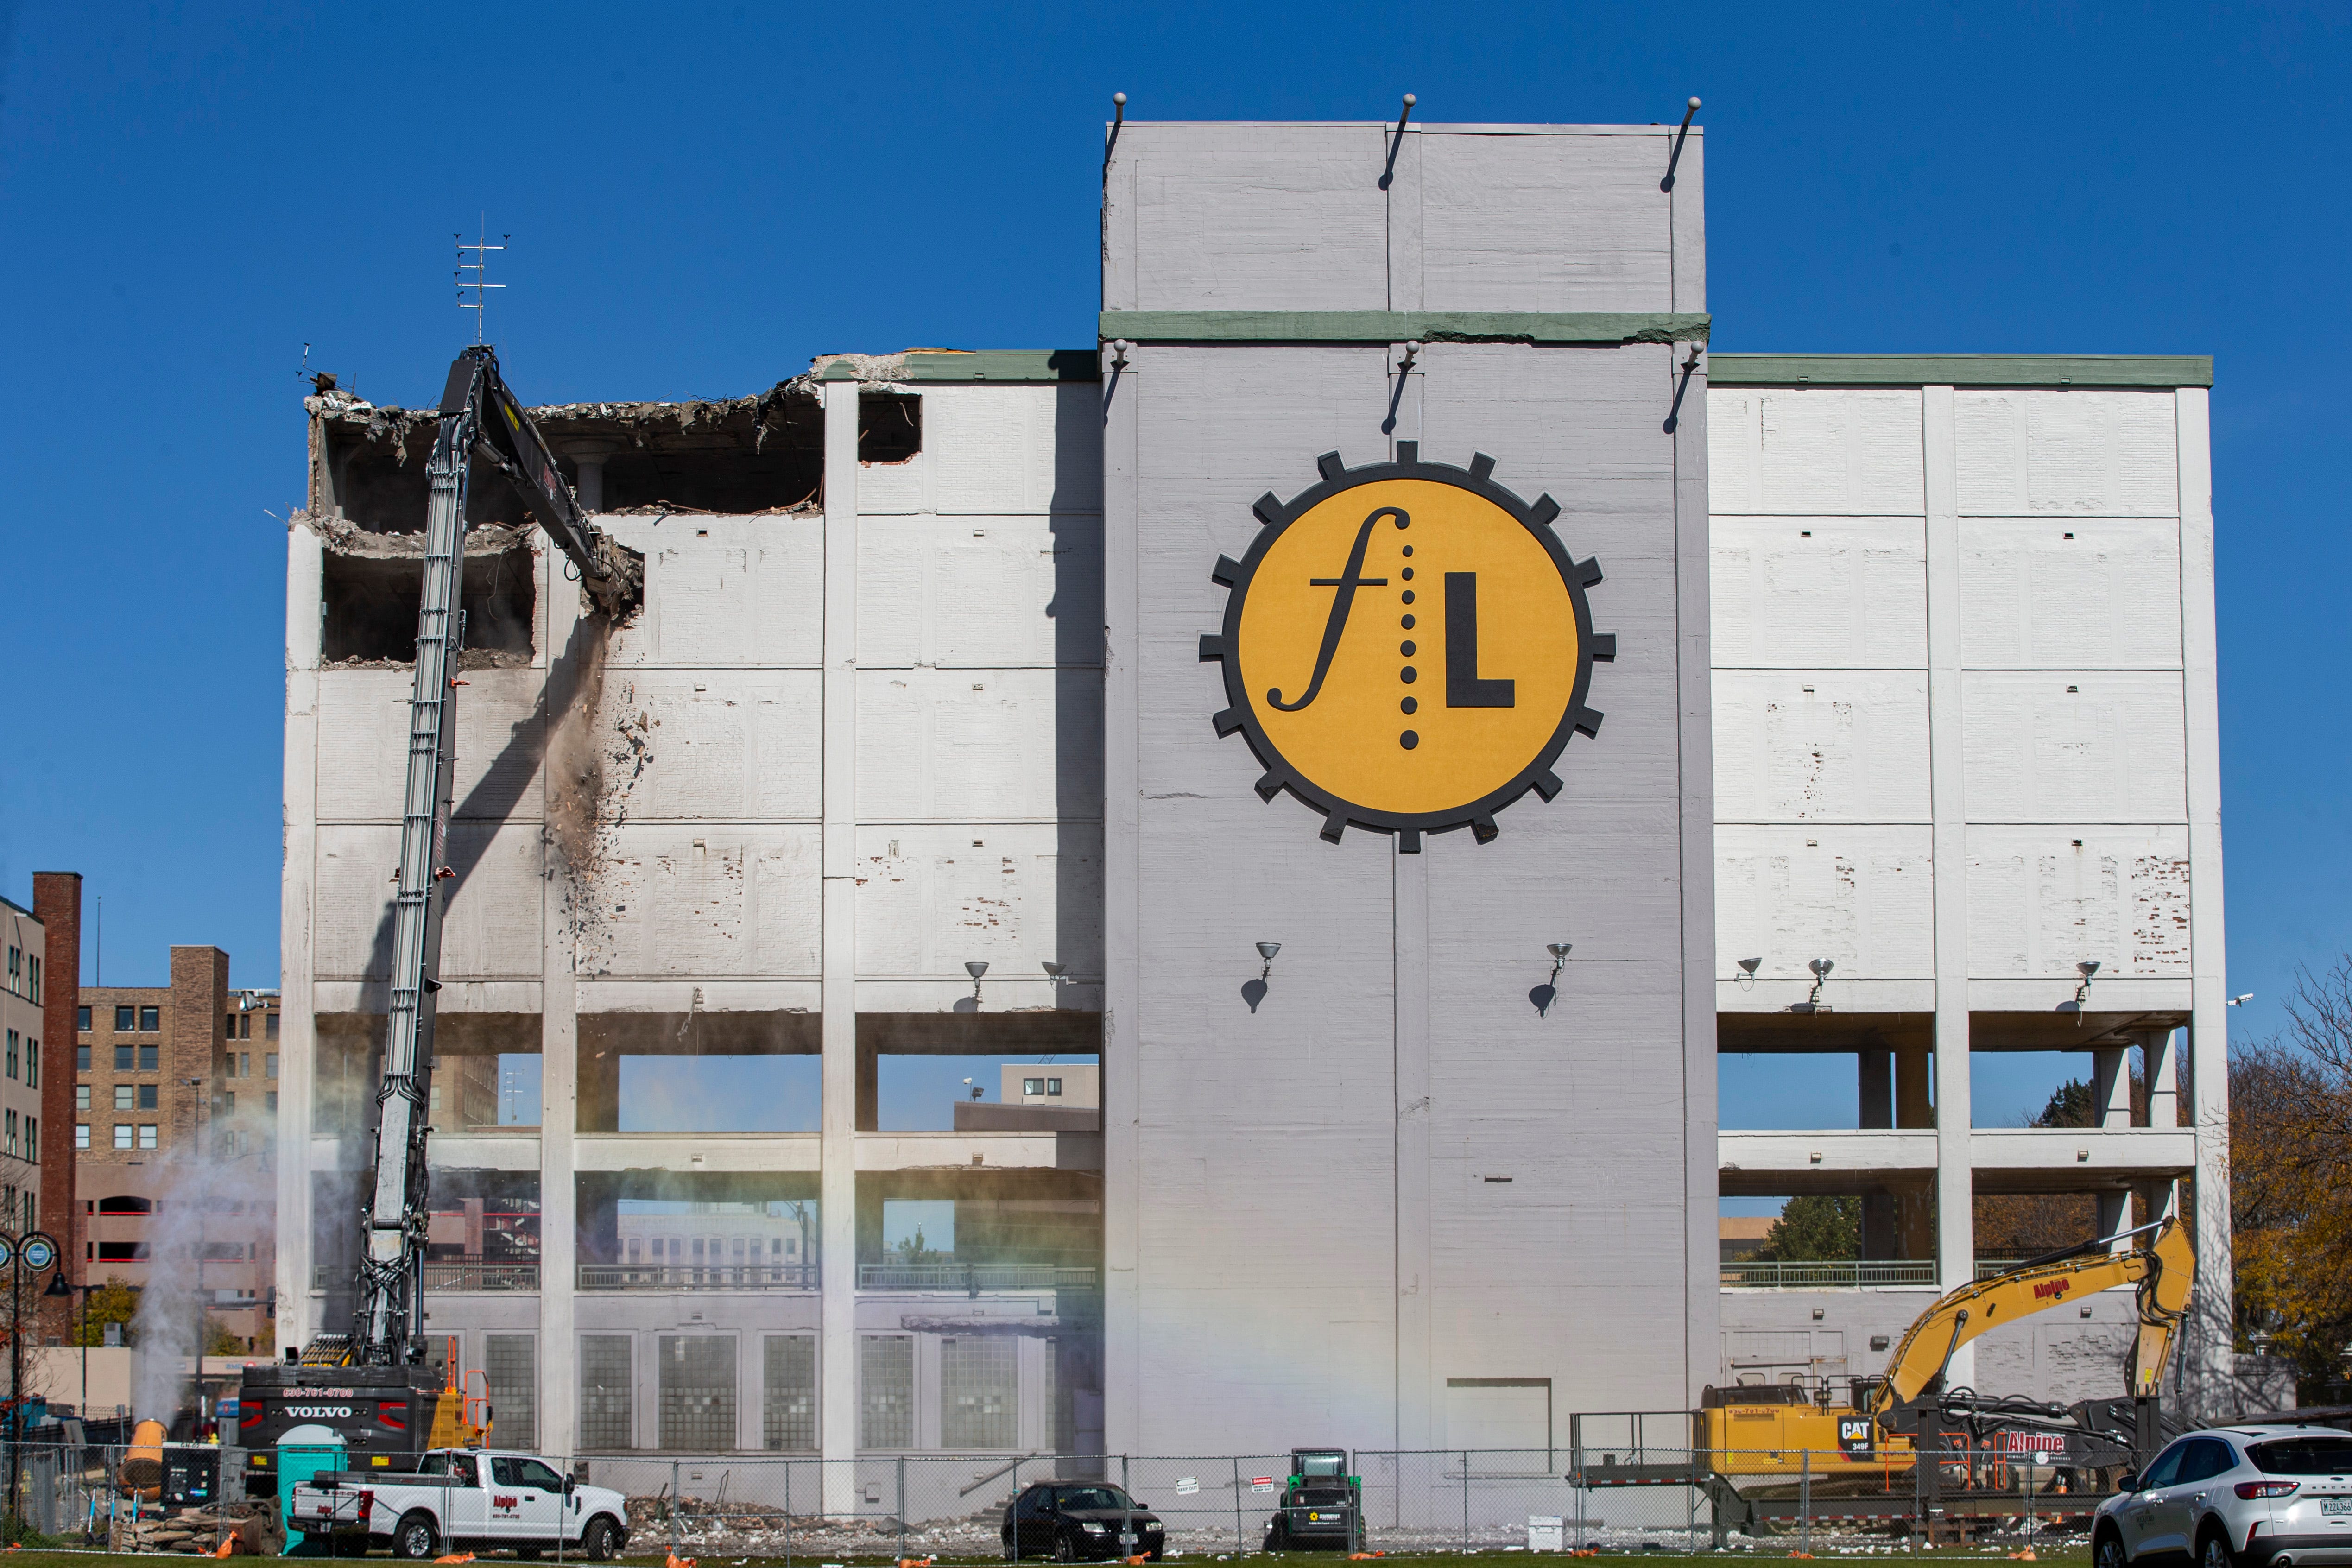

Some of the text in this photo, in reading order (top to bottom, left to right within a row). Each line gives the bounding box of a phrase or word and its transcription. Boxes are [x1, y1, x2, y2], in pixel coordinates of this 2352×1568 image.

[2033, 1279, 2070, 1300] Alpine
[283, 1387, 354, 1397] 630-761-0700
[285, 1406, 352, 1418] VOLVO
[1841, 1422, 1870, 1440] CAT
[2007, 1431, 2064, 1455] Alpine
[493, 1495, 518, 1509] Alpine
[2329, 1502, 2351, 1511] 224366
